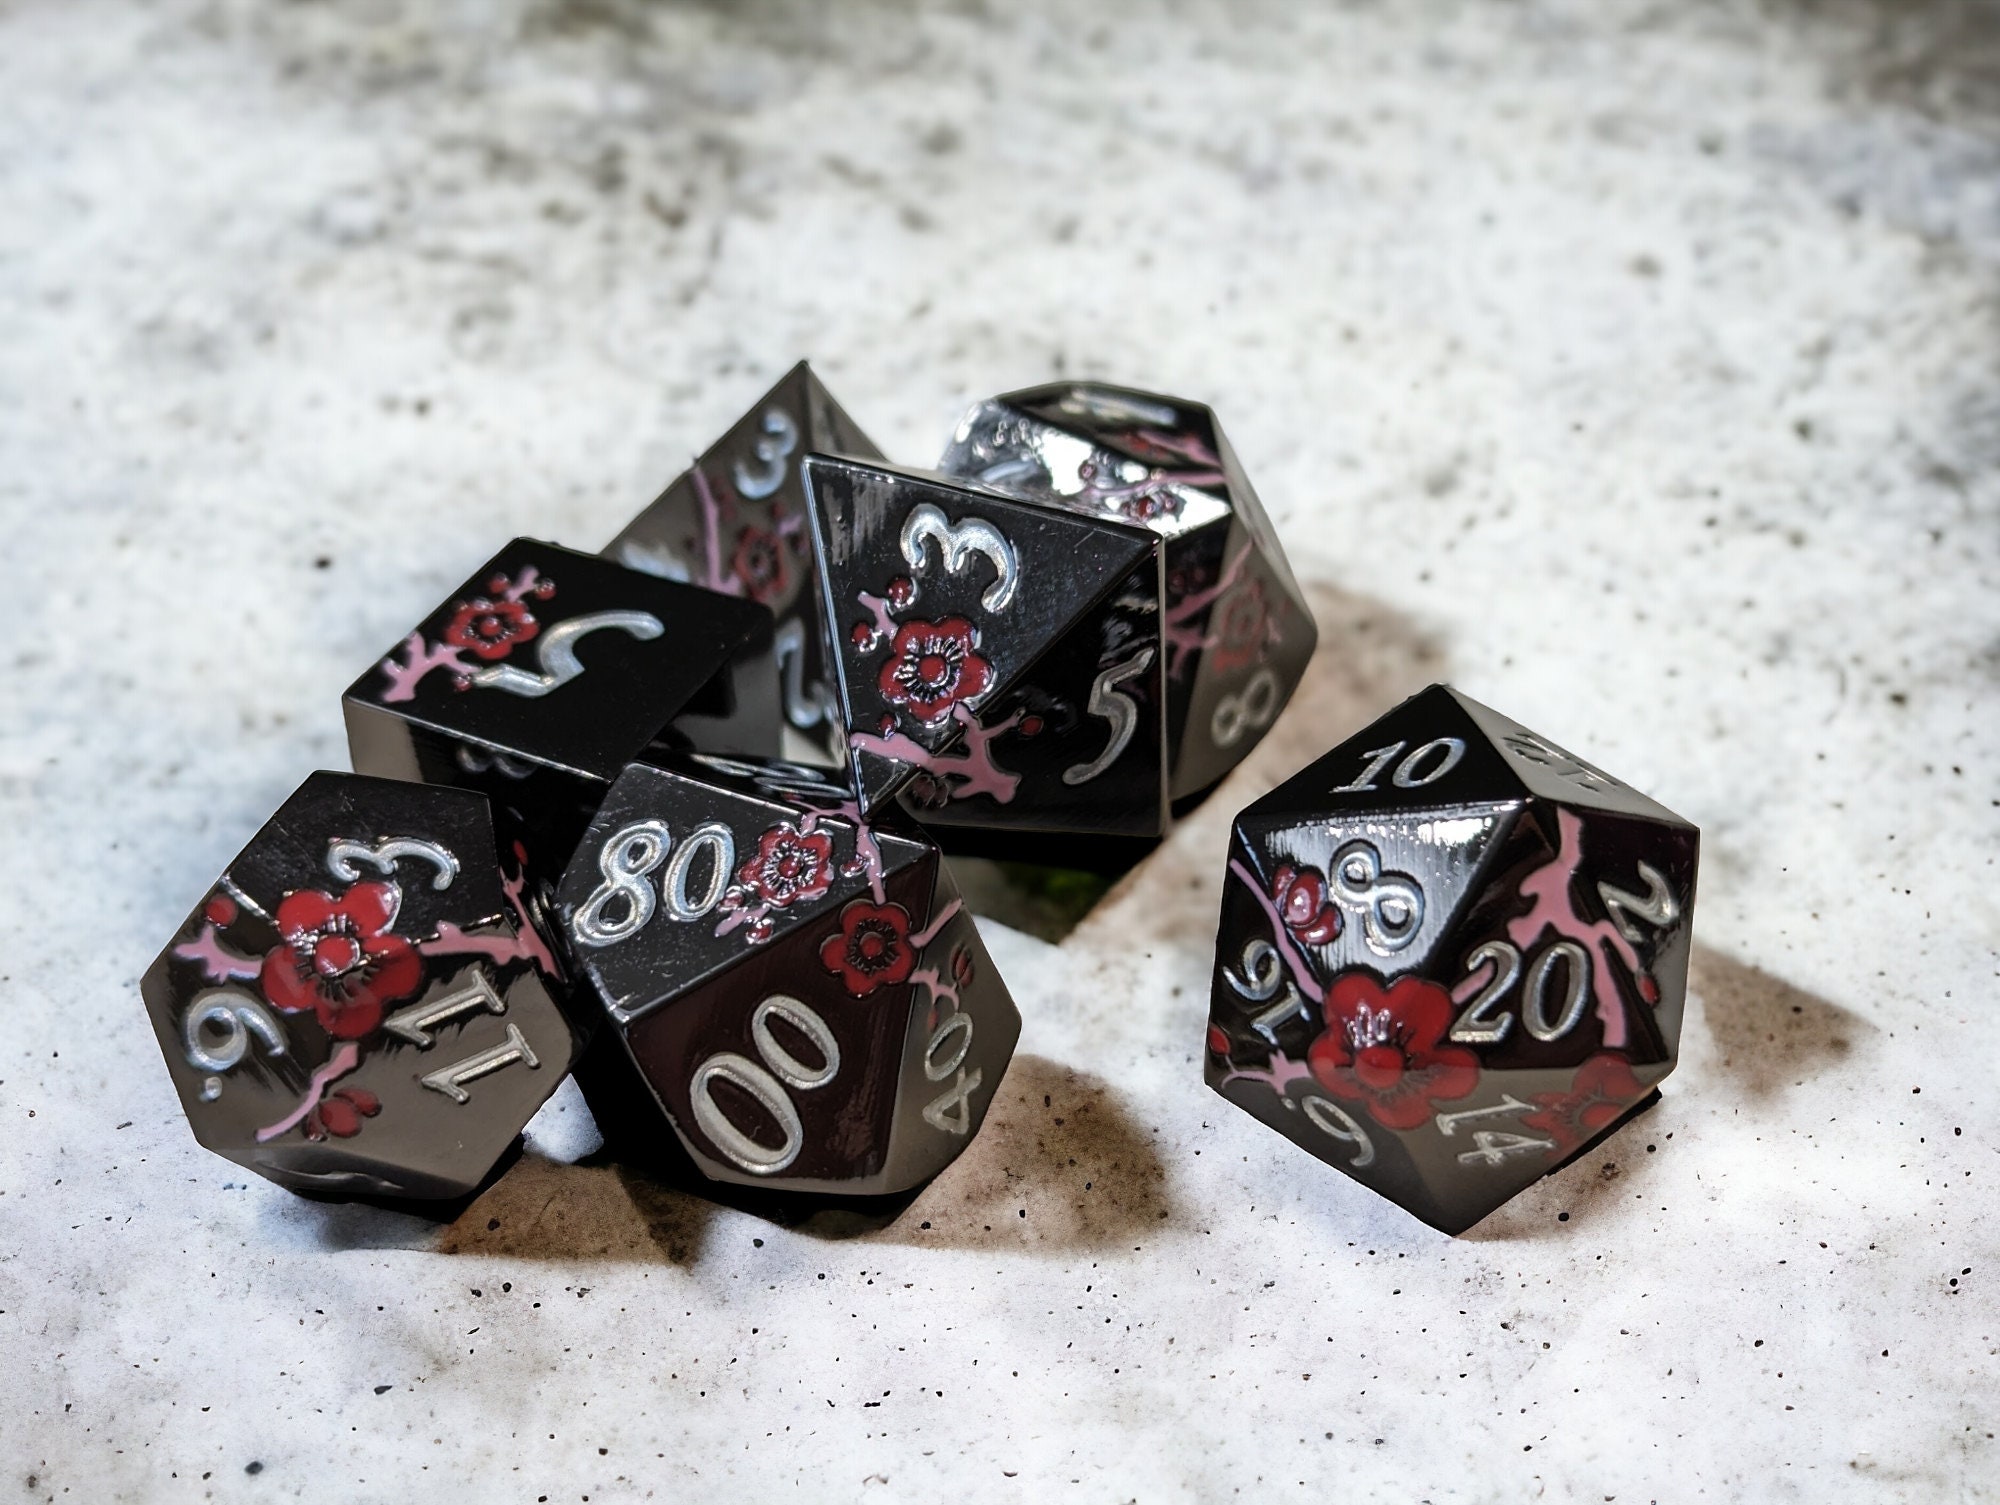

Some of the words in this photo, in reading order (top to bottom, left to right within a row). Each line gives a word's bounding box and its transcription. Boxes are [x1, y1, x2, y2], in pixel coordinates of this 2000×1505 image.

[900, 503, 1018, 613] 3
[1062, 648, 1155, 786] 5
[1211, 669, 1276, 747] 8
[1329, 736, 1466, 793] 10
[327, 836, 460, 891] 3
[573, 818, 735, 946] 80
[1328, 837, 1426, 957] 8
[1597, 859, 1680, 940] 2
[383, 968, 542, 1104] 11
[1449, 940, 1593, 1043] 20
[690, 994, 842, 1174] 00
[922, 1011, 984, 1135] 40
[1435, 1092, 1556, 1166] 14
